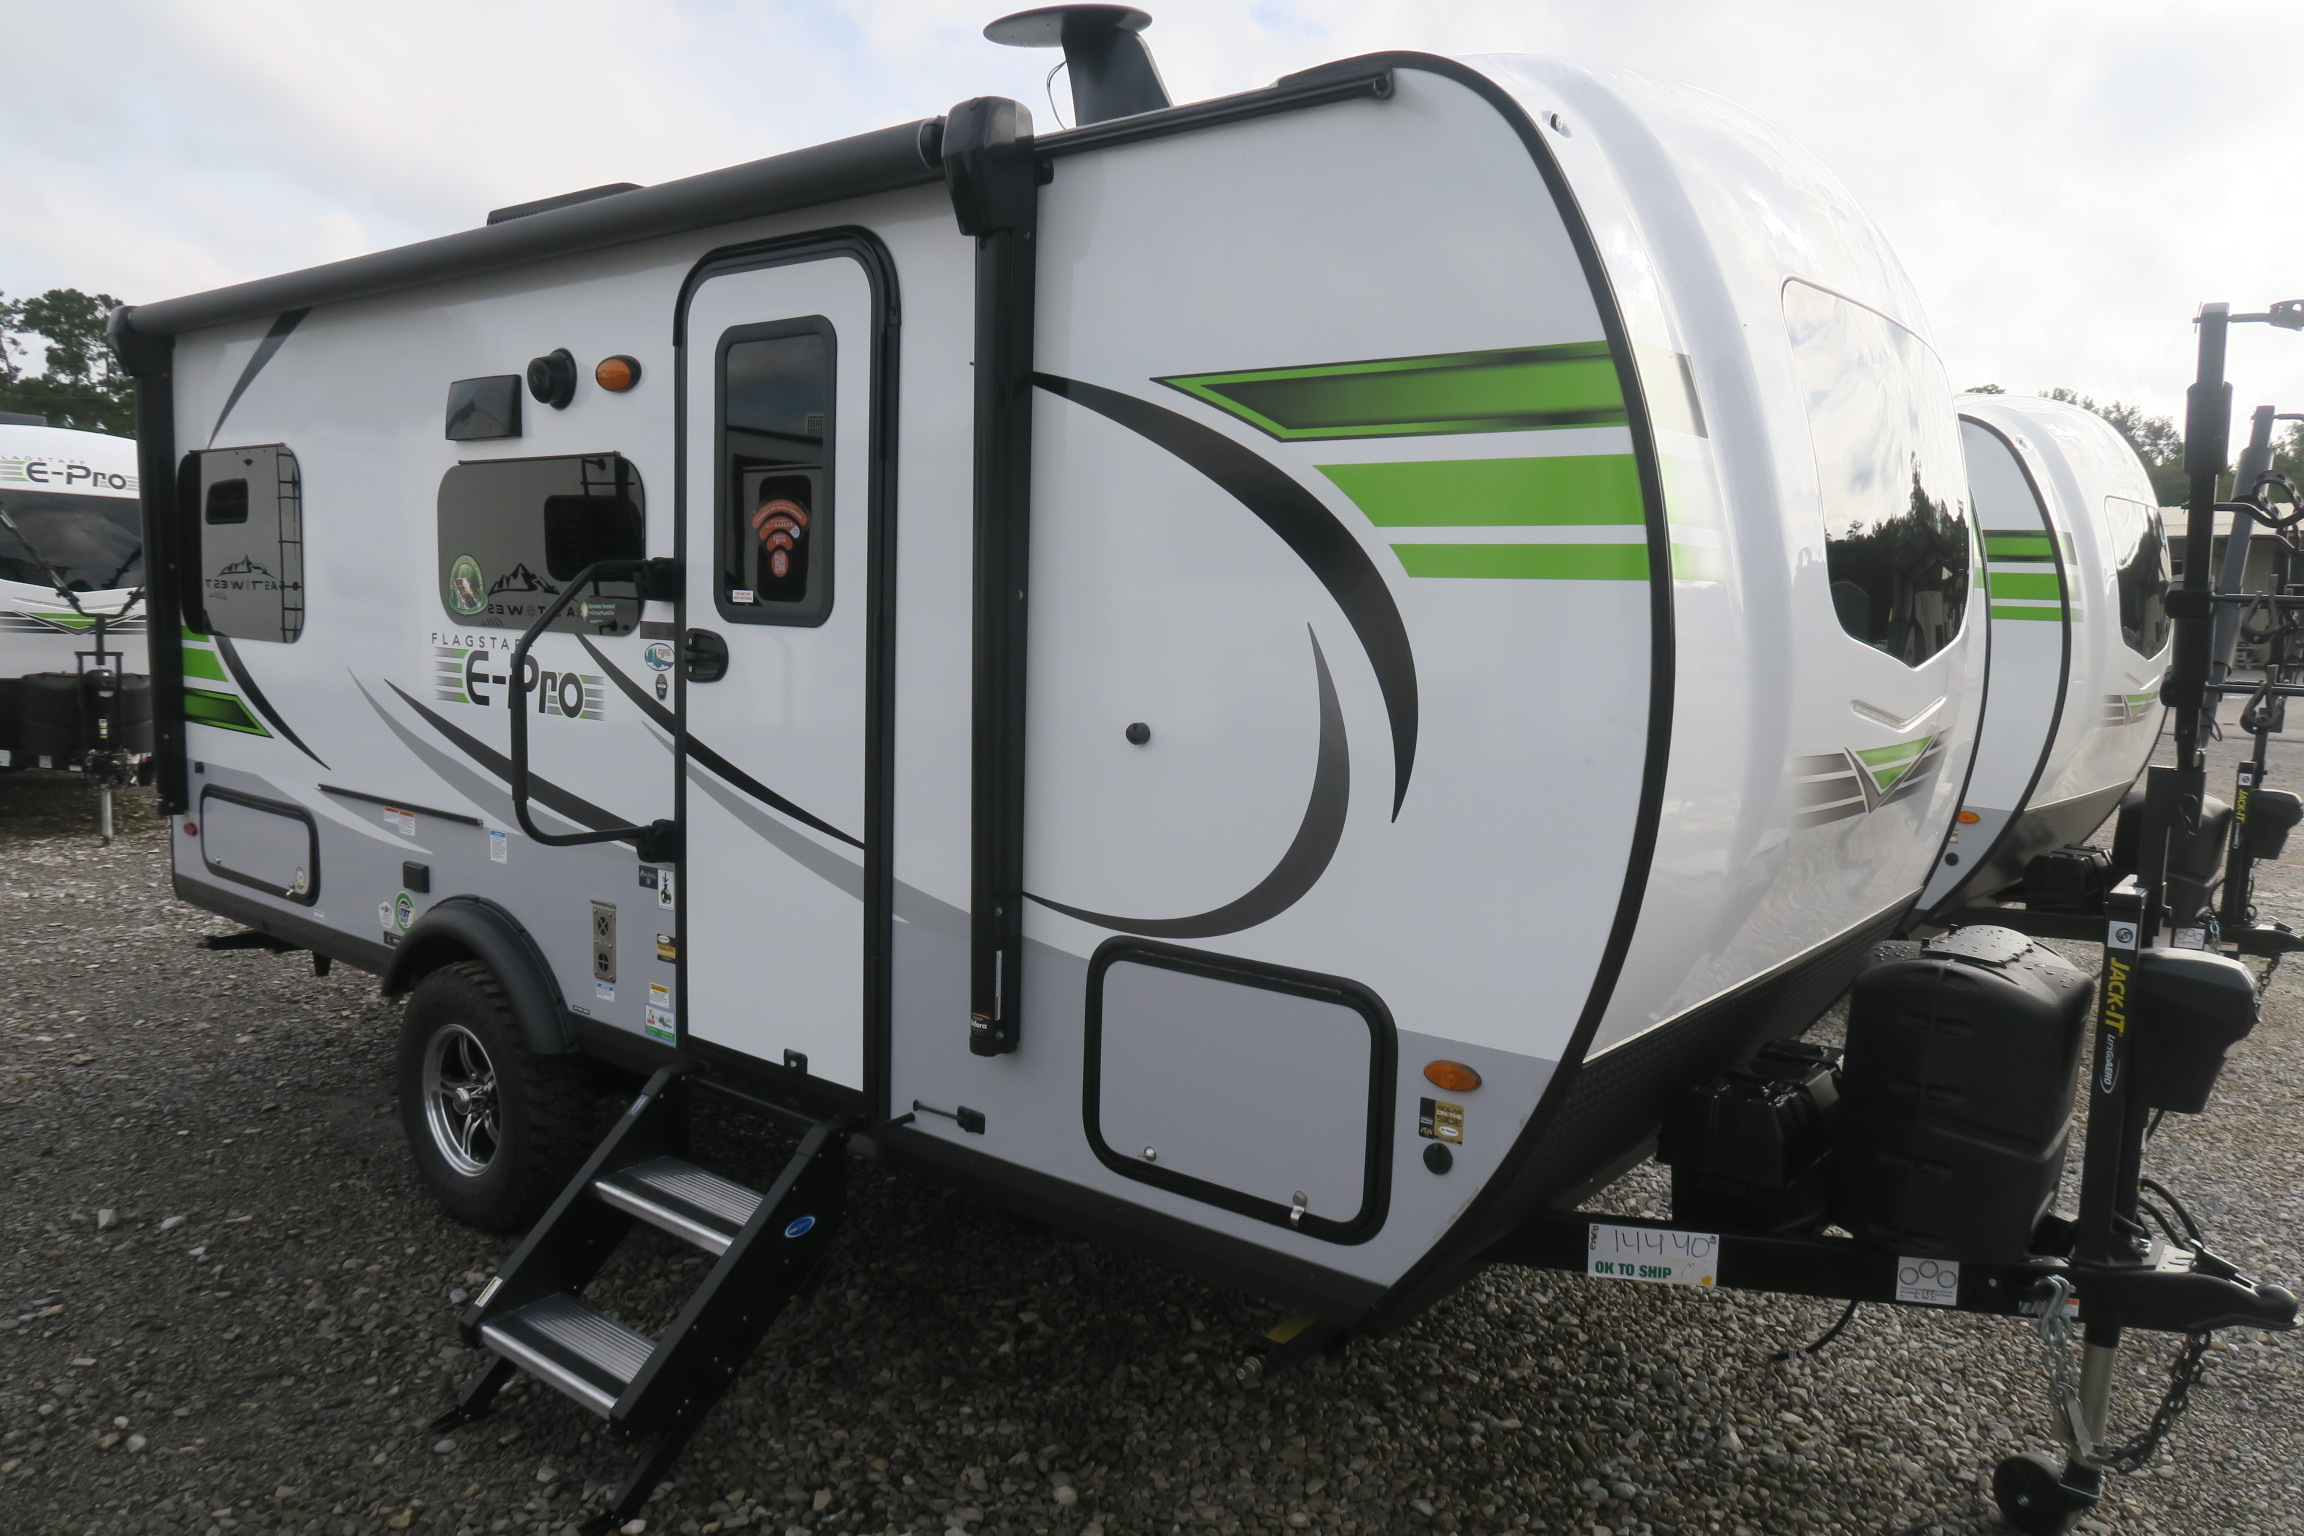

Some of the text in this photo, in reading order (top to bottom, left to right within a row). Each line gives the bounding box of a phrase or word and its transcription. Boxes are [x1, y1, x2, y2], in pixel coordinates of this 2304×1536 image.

[0, 455, 86, 465] LAGSTAFF
[26, 462, 127, 490] E-Pro
[2105, 956, 2131, 1034] JACK-IT
[1437, 1115, 1462, 1127] SIDE
[1595, 1261, 1614, 1275] OK
[1618, 1263, 1635, 1276] TO
[1639, 1265, 1672, 1279] SHIP
